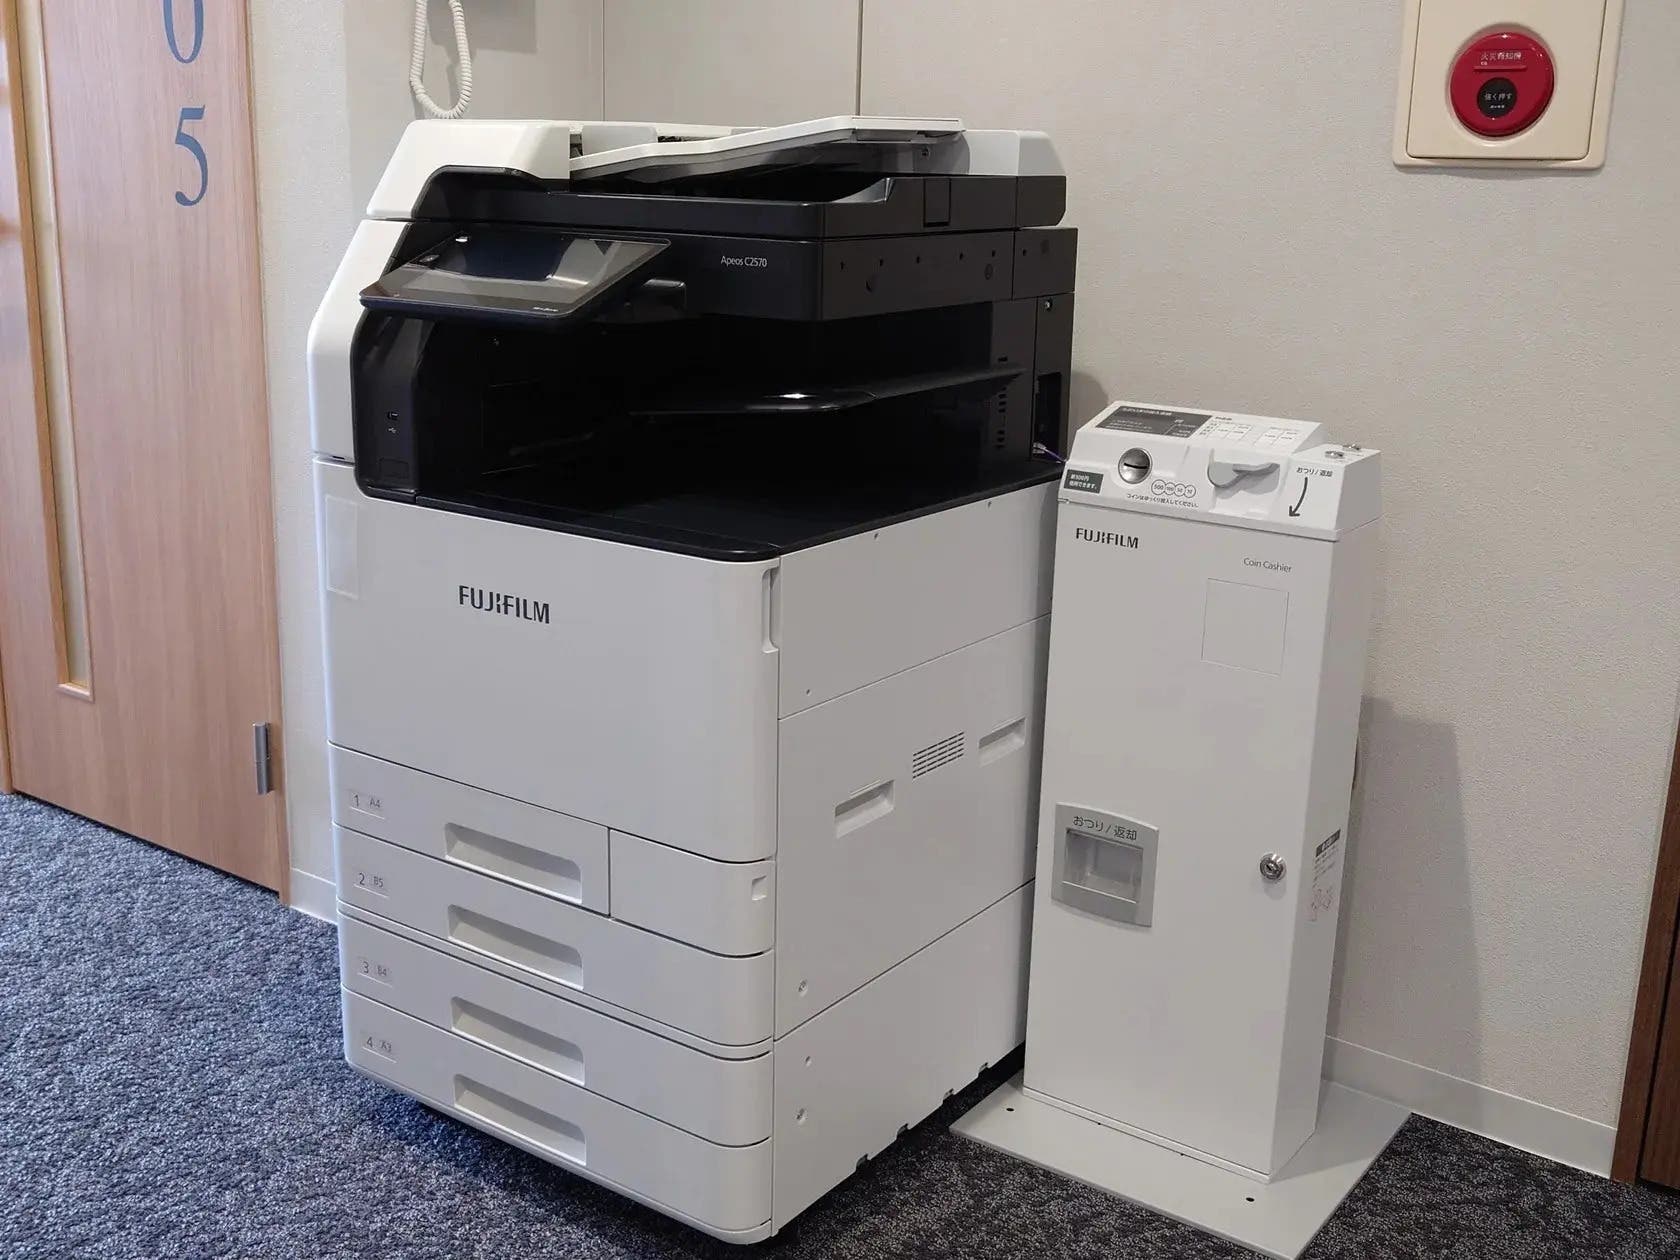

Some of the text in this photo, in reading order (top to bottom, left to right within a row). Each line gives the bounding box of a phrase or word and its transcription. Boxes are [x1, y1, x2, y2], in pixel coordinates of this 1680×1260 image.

[720, 255, 768, 268] Apeos C2570
[1154, 483, 1165, 491] 500
[1076, 527, 1140, 549] FUJIFILM
[1243, 557, 1292, 573] Coin Cashier
[459, 585, 550, 624] FUJIFILM
[353, 794, 381, 808] 1 A4
[359, 872, 365, 886] 2
[363, 960, 369, 974] 3
[366, 1036, 373, 1048] 4
